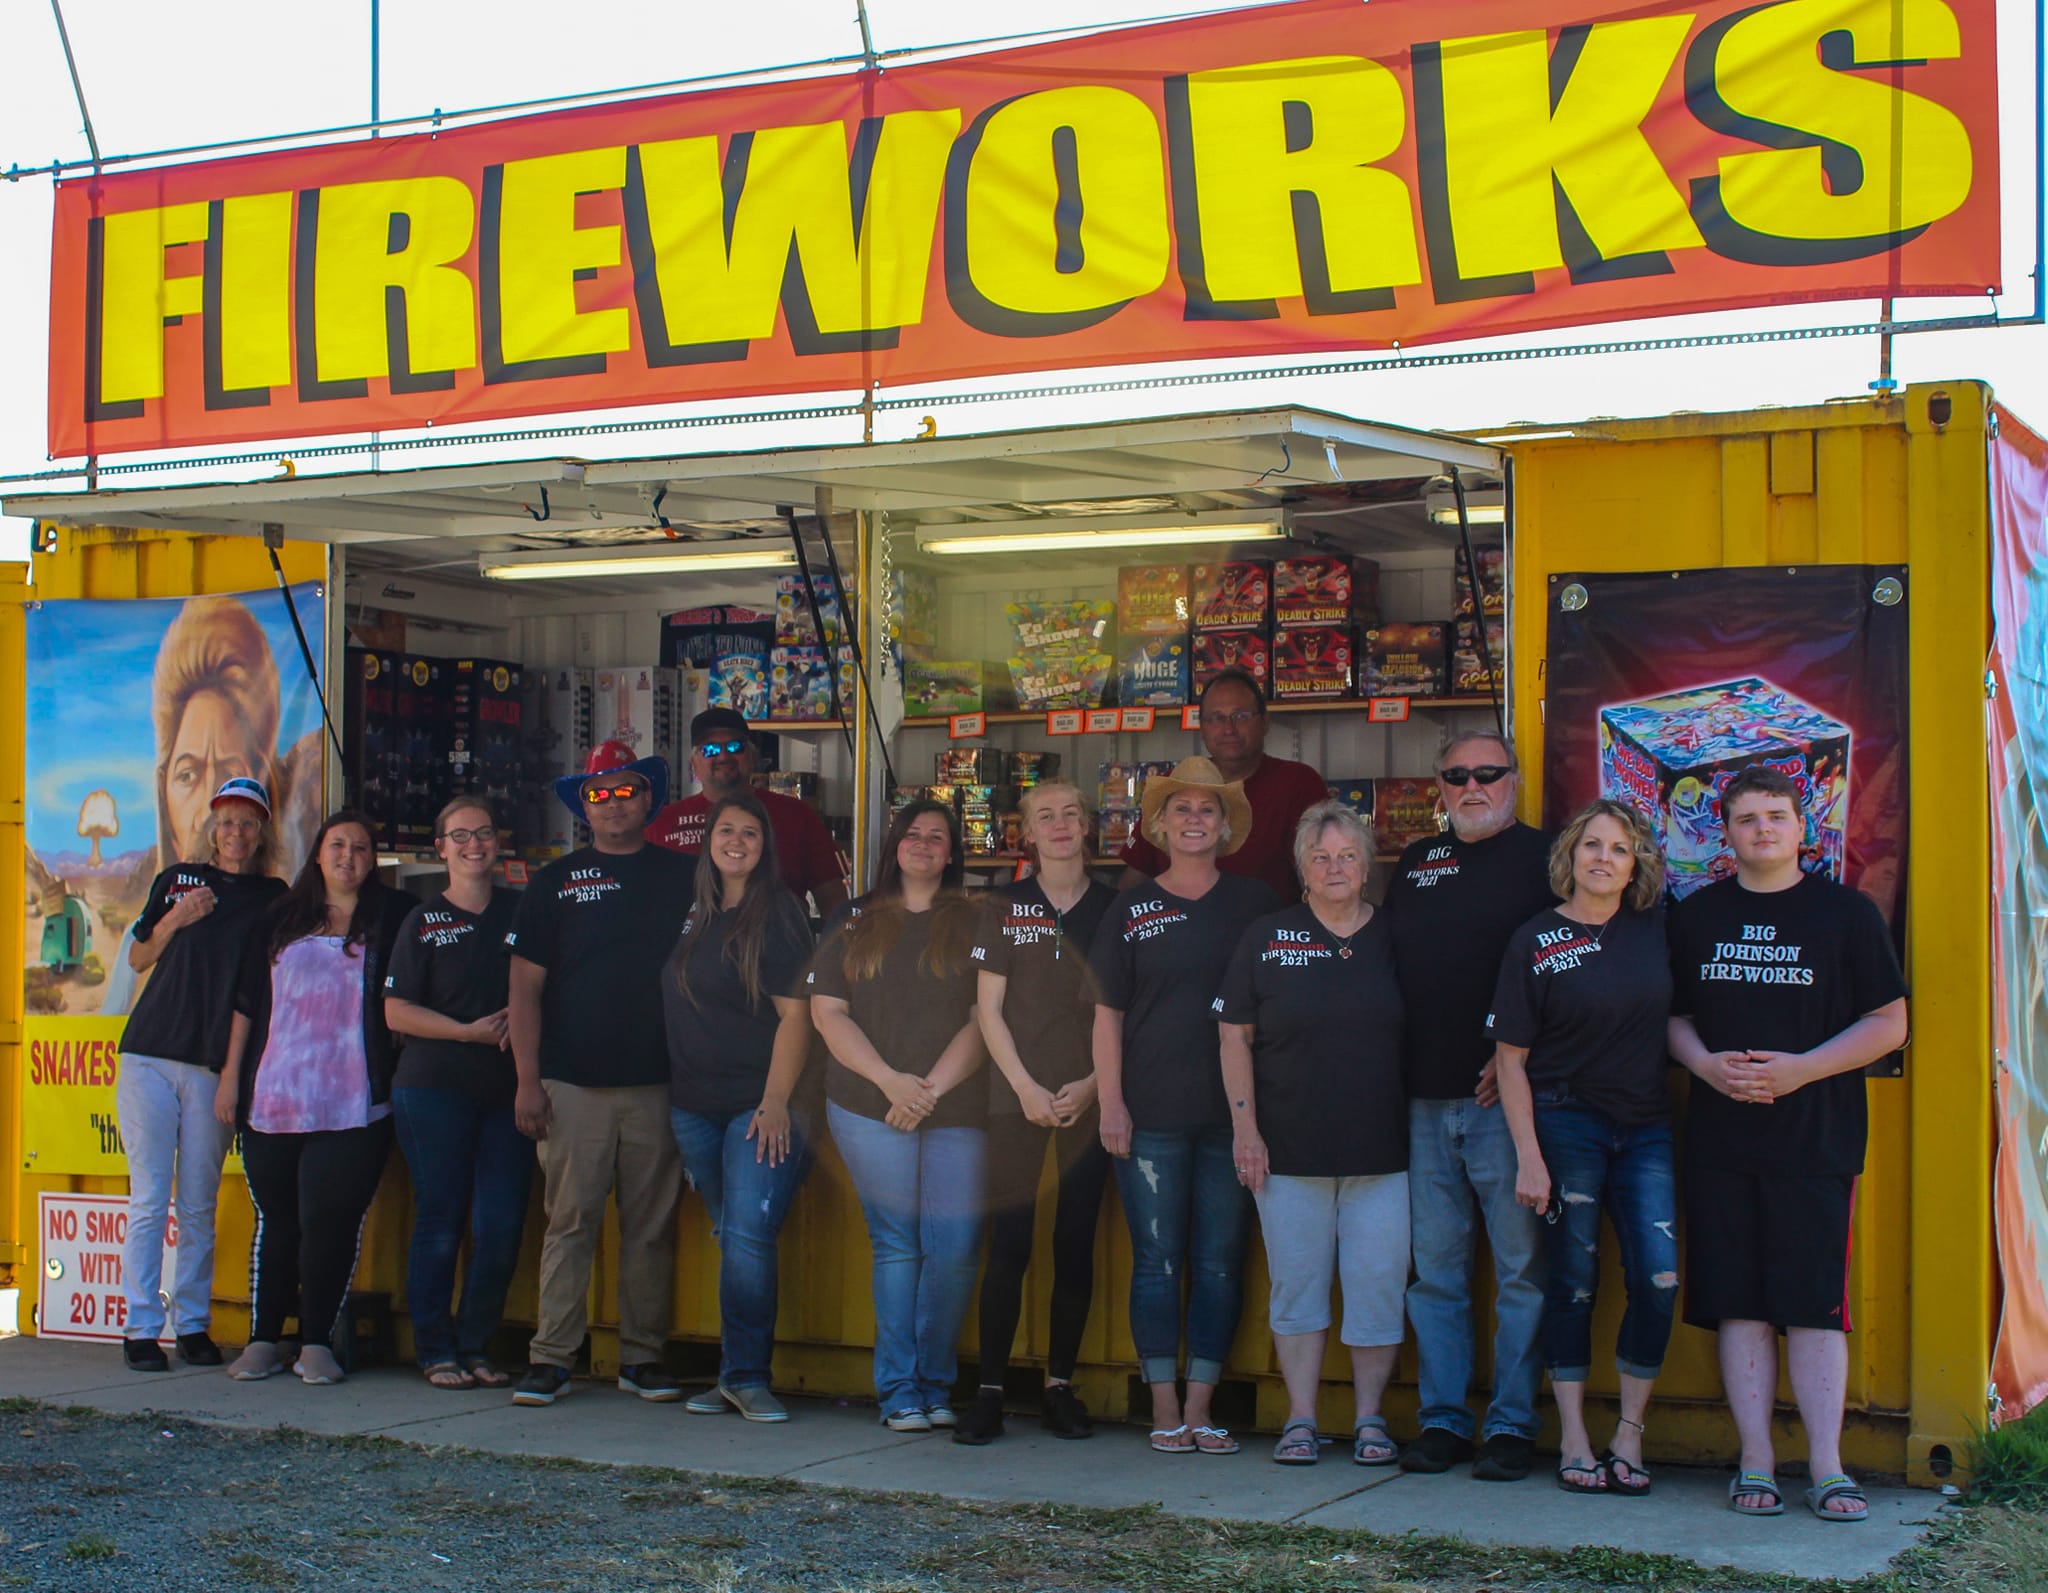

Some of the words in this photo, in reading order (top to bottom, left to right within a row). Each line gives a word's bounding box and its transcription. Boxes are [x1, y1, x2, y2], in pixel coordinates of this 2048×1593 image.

[88, 0, 1974, 420] FIREWORKS
[1196, 614, 1228, 626] DEADLY
[1231, 611, 1263, 624] STRIKE
[1277, 609, 1311, 622] DEADLY
[1313, 608, 1347, 620] STRIKE
[1134, 660, 1178, 681] HUGE
[1277, 680, 1311, 692] DEADLY
[1313, 679, 1346, 691] STRIKE
[679, 814, 706, 825] BIG
[1427, 846, 1452, 861] BIG
[570, 867, 601, 880] BIG
[1407, 866, 1460, 879] FIREWORKS
[1416, 875, 1438, 888] 2021
[557, 883, 621, 899] FIREWORKS
[575, 890, 601, 903] 2021
[1012, 903, 1045, 917] BIG
[1129, 900, 1164, 918] BIG
[423, 911, 452, 923] BIG
[1123, 913, 1188, 942] FIREWORKS
[1138, 925, 1165, 941] 2021
[1741, 924, 1777, 941] BIG
[1014, 932, 1039, 945] 2021
[1276, 928, 1311, 943] BIG
[1536, 926, 1574, 948] BIG
[1261, 948, 1333, 962] FIREWORKS
[1712, 942, 1802, 962] JOHNSON
[1279, 955, 1309, 966] 2021
[1551, 955, 1582, 974] 2021
[1700, 963, 1814, 986] FIREWORKS
[31, 1039, 117, 1087] SNAKES
[50, 1209, 78, 1242] NO
[70, 1292, 97, 1326] 20
